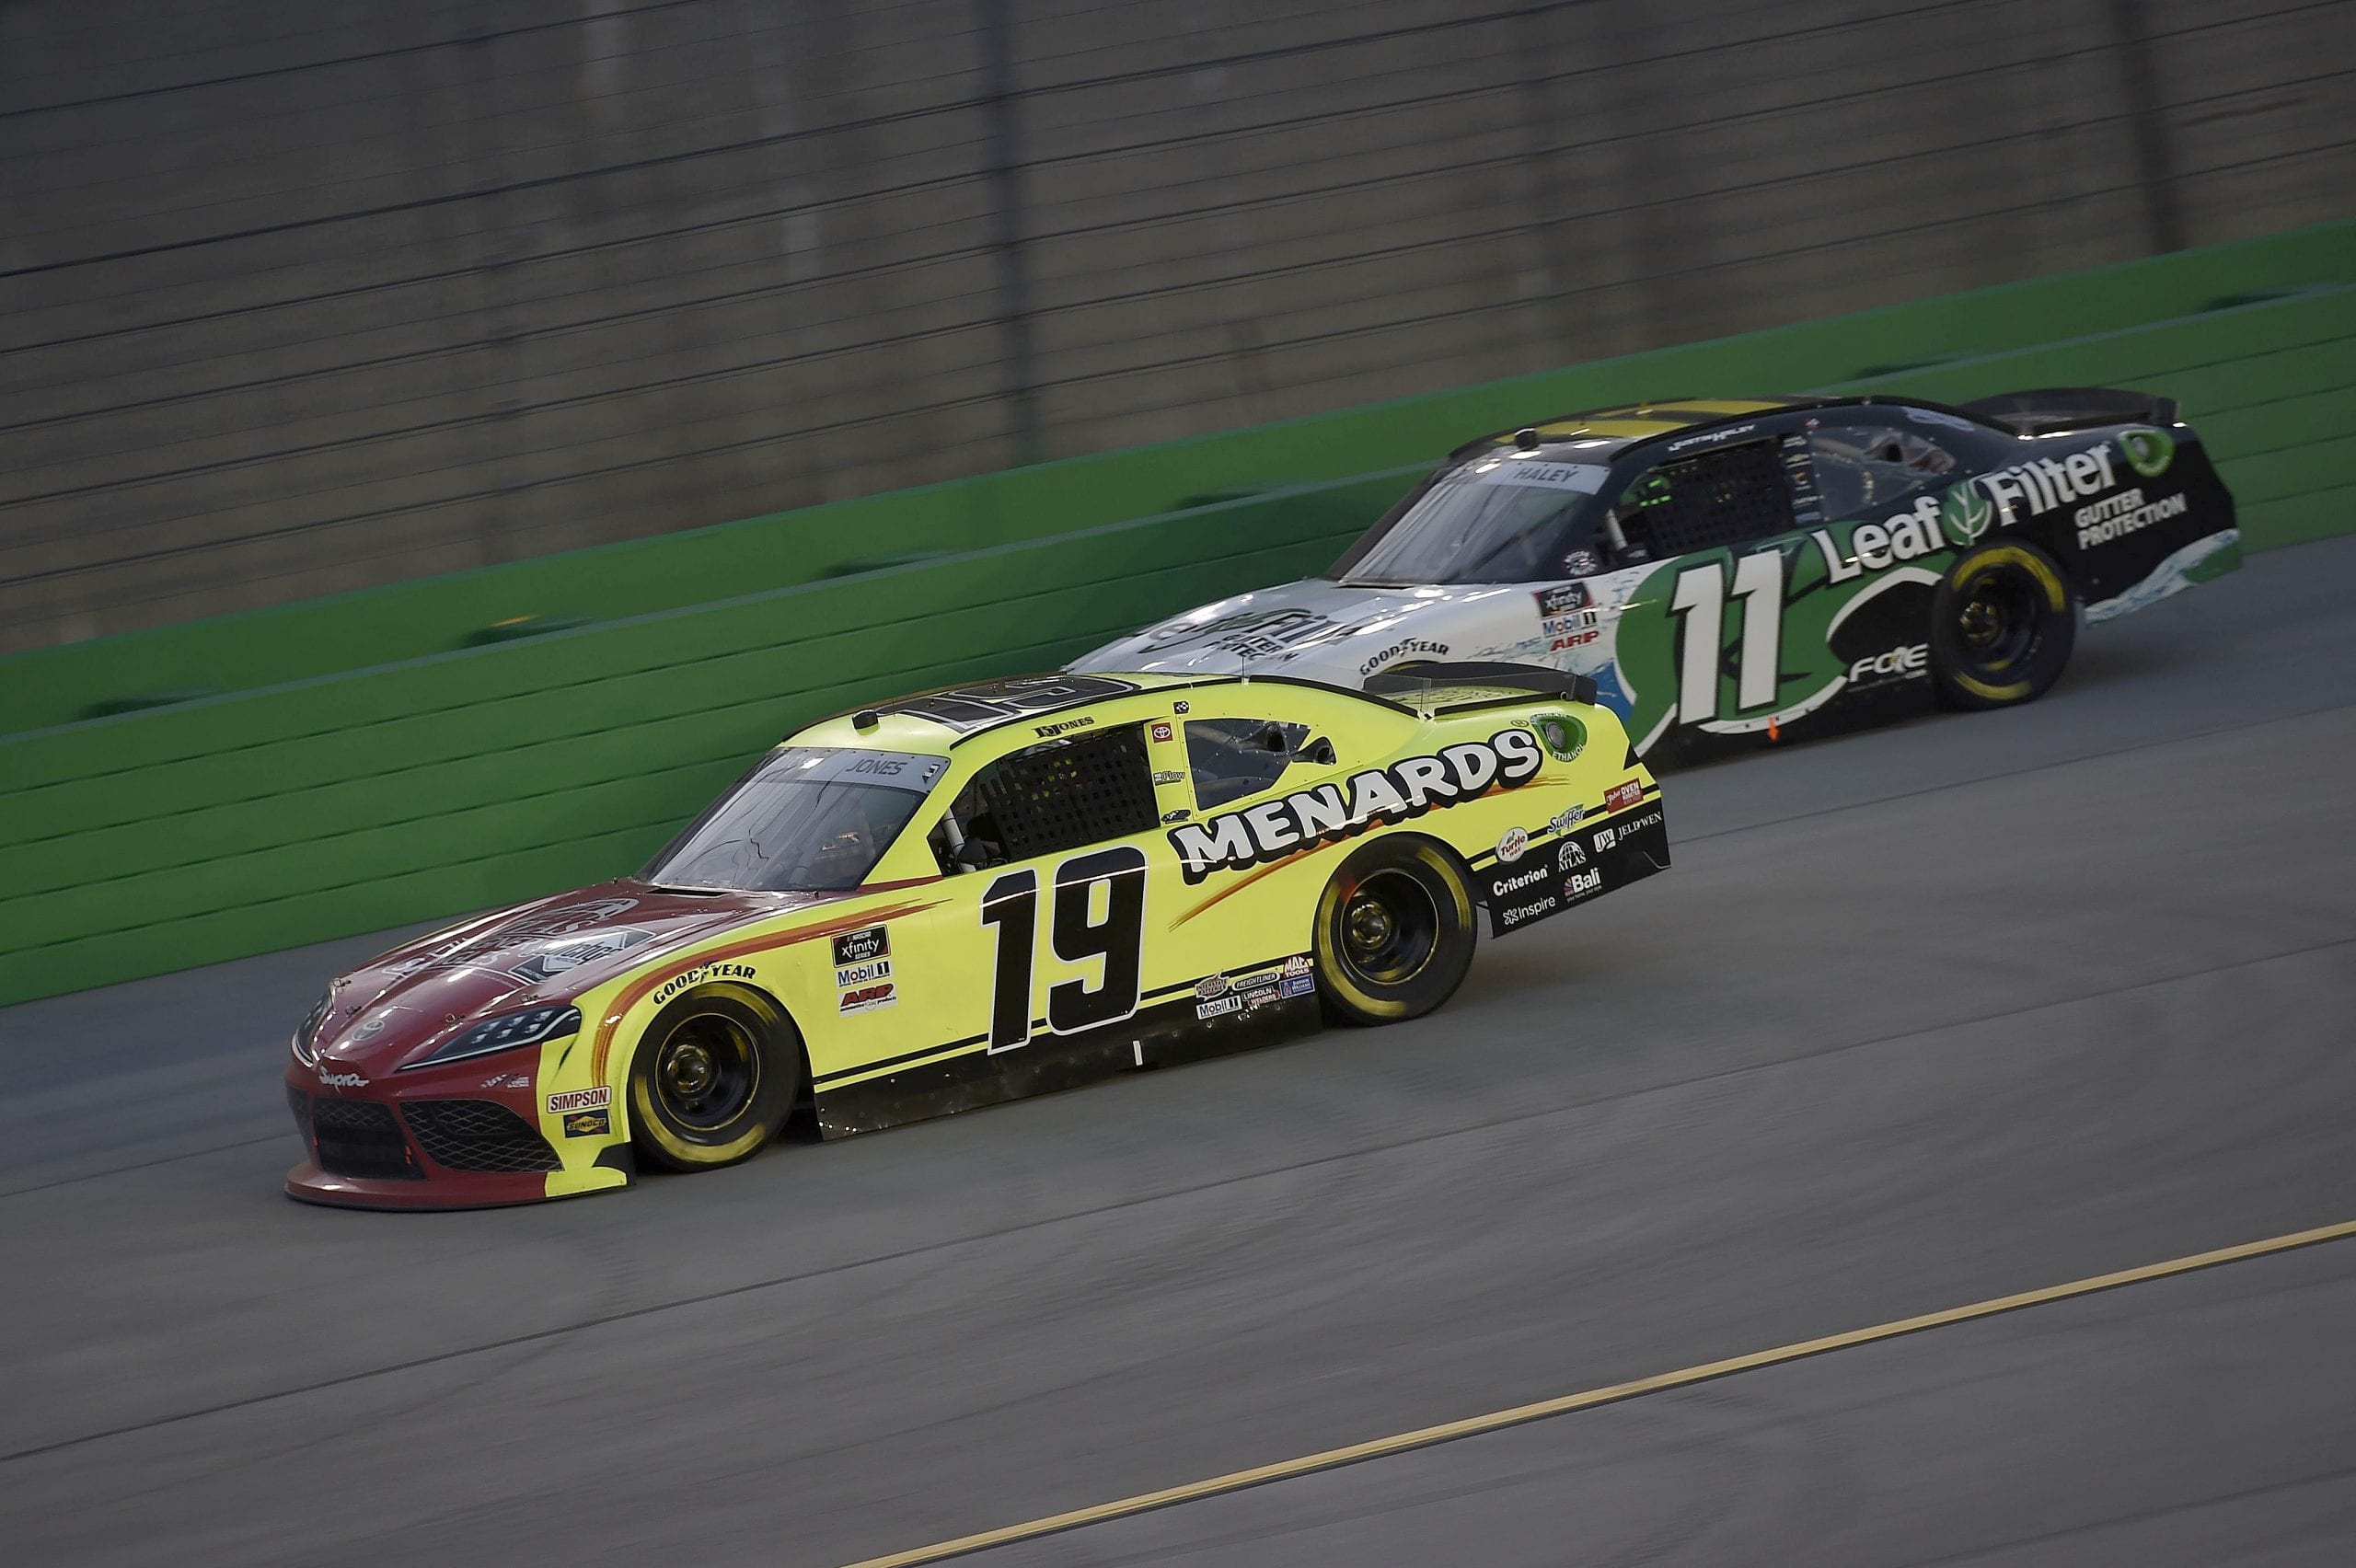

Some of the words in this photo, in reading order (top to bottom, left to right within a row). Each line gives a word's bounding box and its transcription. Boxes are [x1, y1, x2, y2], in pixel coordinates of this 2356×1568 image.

[1513, 467, 1579, 482] HALEY
[1810, 496, 1945, 584] Leaf
[1979, 443, 2116, 527] Filter
[2074, 488, 2145, 528] GUTTER
[2078, 492, 2188, 550] PROTECTION
[1550, 631, 1600, 651] ARP
[1670, 548, 1784, 725] 11
[1360, 638, 1449, 675] GOODYEAR
[1552, 744, 1584, 762] ETHANOL
[846, 759, 908, 776] JONES
[1621, 780, 1639, 795] OVEN
[1172, 728, 1542, 881] MENARDS
[1547, 807, 1585, 834] Swiffer
[1501, 836, 1526, 856] Turtle
[1558, 853, 1587, 872] ATLAS
[1493, 868, 1548, 896] Criterion
[1571, 867, 1601, 893] Bali
[1518, 896, 1556, 919] Inspire
[841, 939, 880, 958] xfinity
[981, 846, 1147, 1055] 19
[837, 963, 874, 985] Mobil
[877, 961, 890, 975] 1
[1285, 956, 1309, 973] MAC
[1285, 967, 1311, 978] TOOLS
[653, 960, 756, 1005] GOODYEAR
[1236, 973, 1276, 988] FREIGHTLINER
[840, 983, 895, 1008] ARP
[1243, 986, 1272, 1000] LINCOLN
[1199, 1002, 1228, 1018] Mobil
[318, 1066, 370, 1094] Supra
[550, 1089, 607, 1111] SIMPSON
[568, 1119, 606, 1130] SUNOCO
